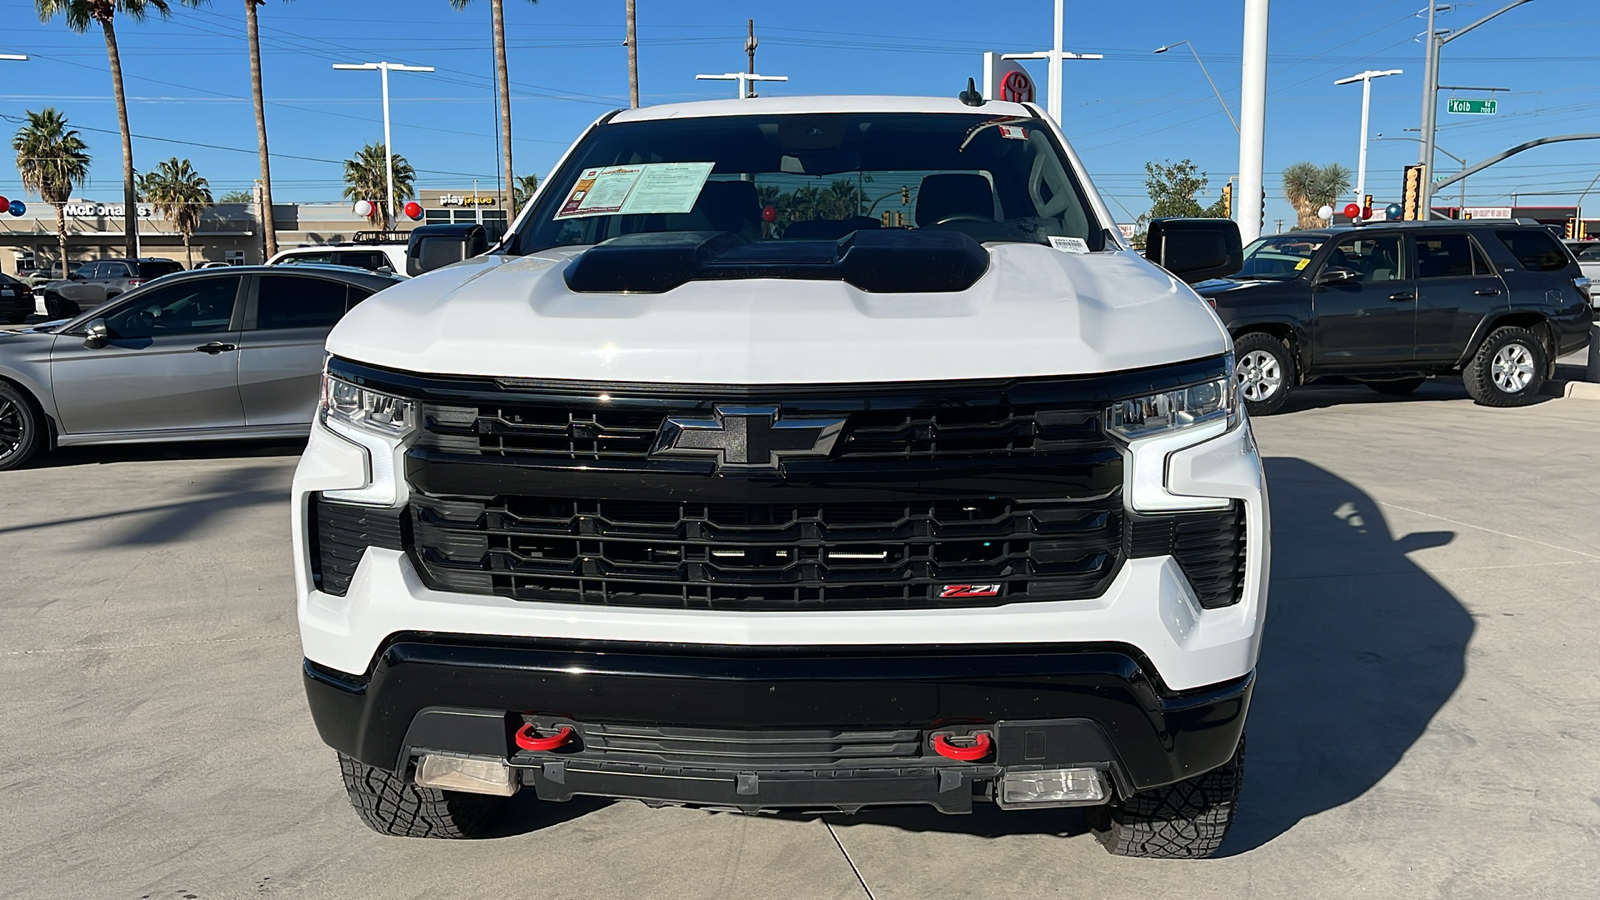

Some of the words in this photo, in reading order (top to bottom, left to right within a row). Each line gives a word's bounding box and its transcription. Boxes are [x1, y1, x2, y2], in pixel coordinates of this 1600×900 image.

[1453, 101, 1471, 112] Kolb
[62, 203, 147, 217] McDonal's
[939, 584, 1001, 598] Z71
